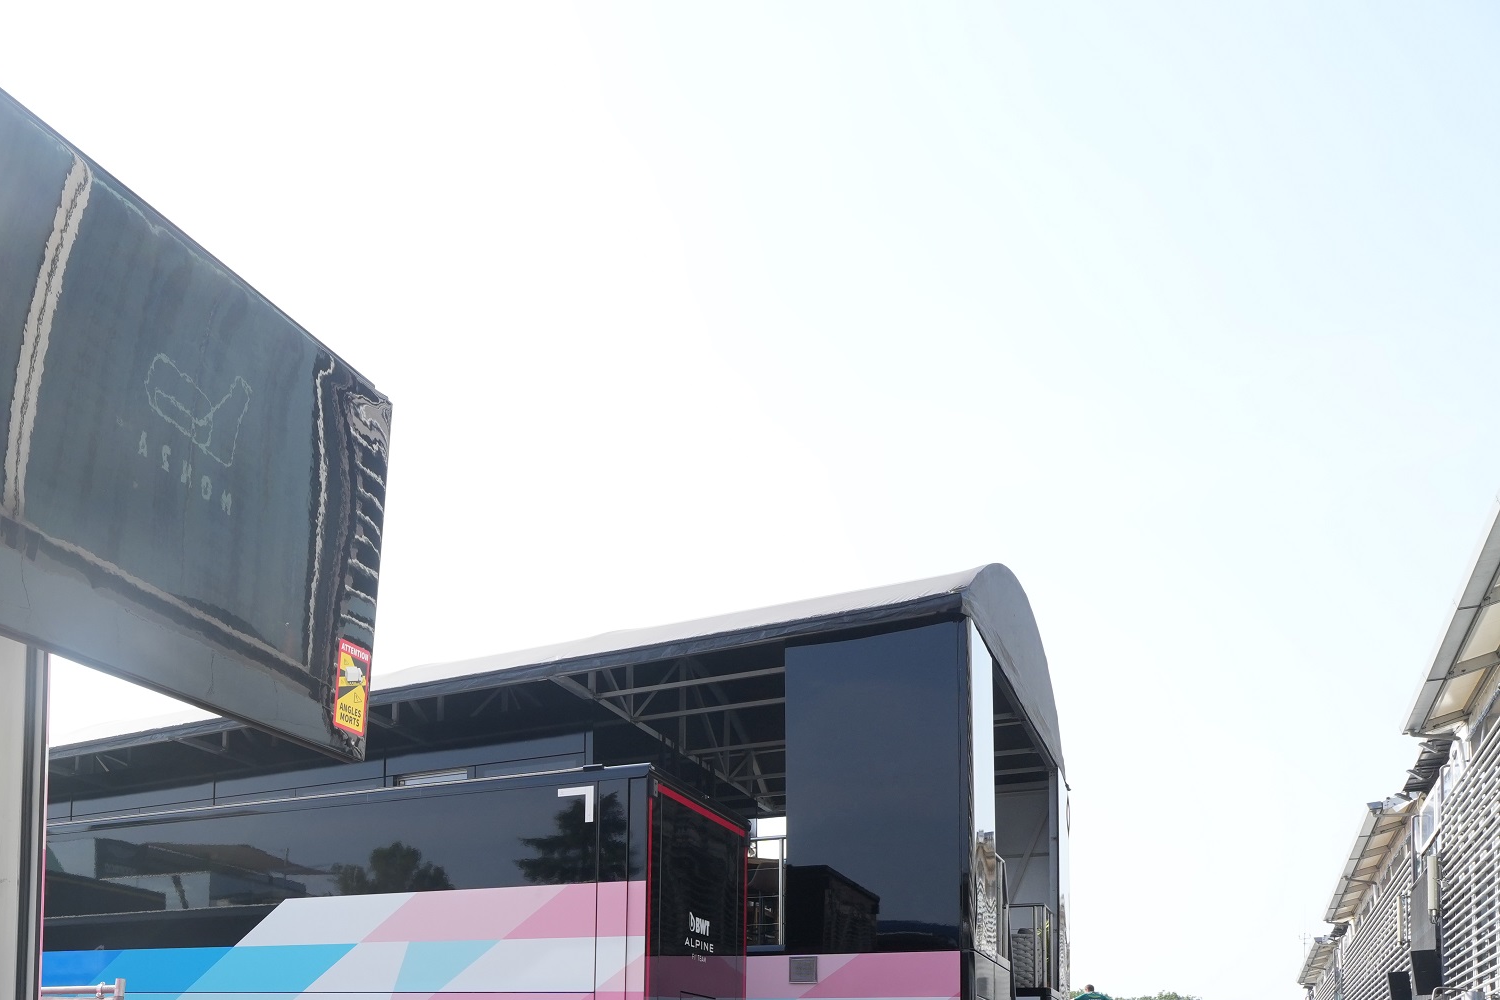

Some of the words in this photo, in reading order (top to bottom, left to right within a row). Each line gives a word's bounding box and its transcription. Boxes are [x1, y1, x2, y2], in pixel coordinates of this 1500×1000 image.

[341, 643, 369, 662] ATTENTION
[339, 702, 362, 718] ANGLES
[339, 712, 360, 727] MORTS
[695, 916, 710, 937] BWT
[684, 936, 714, 953] ALPINE
